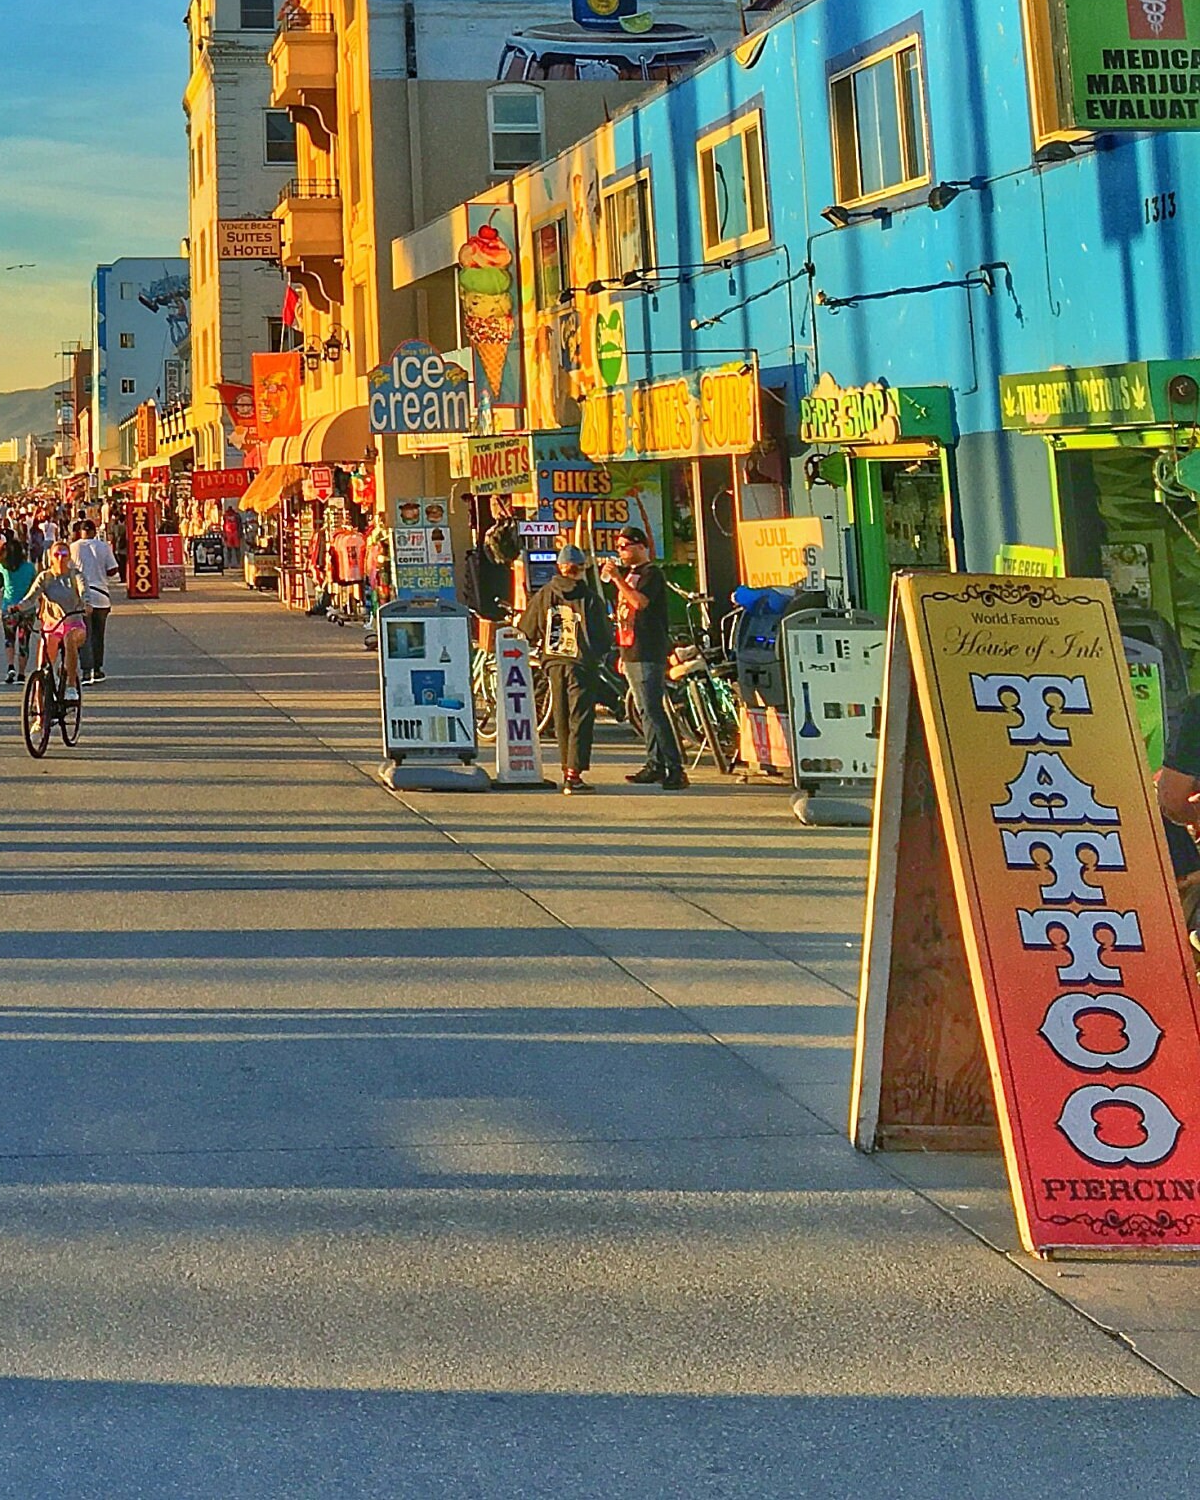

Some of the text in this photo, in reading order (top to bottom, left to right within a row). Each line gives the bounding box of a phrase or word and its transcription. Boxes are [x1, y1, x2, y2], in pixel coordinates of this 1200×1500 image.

[1144, 191, 1177, 225] 1313
[226, 231, 272, 243] SUITES
[251, 222, 277, 230] BEACH
[222, 245, 278, 256] & HOTEL
[1016, 375, 1131, 416] THE GREEN DOCTORS
[370, 391, 469, 430] cream
[701, 372, 753, 448] SURF
[842, 389, 887, 438] SHOP
[493, 437, 520, 449] RINGS
[471, 445, 529, 482] ANKLETS
[196, 473, 244, 489] TATTOO
[500, 474, 529, 489] RINGS
[553, 469, 612, 493] BIKES
[553, 498, 629, 523] SKATES
[523, 524, 557, 533] ATM
[755, 527, 793, 547] JUUL
[132, 506, 151, 593] TATTOO
[780, 547, 816, 567] PODS
[1002, 558, 1048, 577] THE GREEN
[398, 576, 455, 589] ICE CREAM
[971, 612, 1060, 626] World Famous
[943, 626, 1104, 667] House of Ink
[505, 665, 531, 741] ATM
[969, 672, 1185, 1169] TATTOO
[1041, 1178, 1200, 1202] PIERCIN
